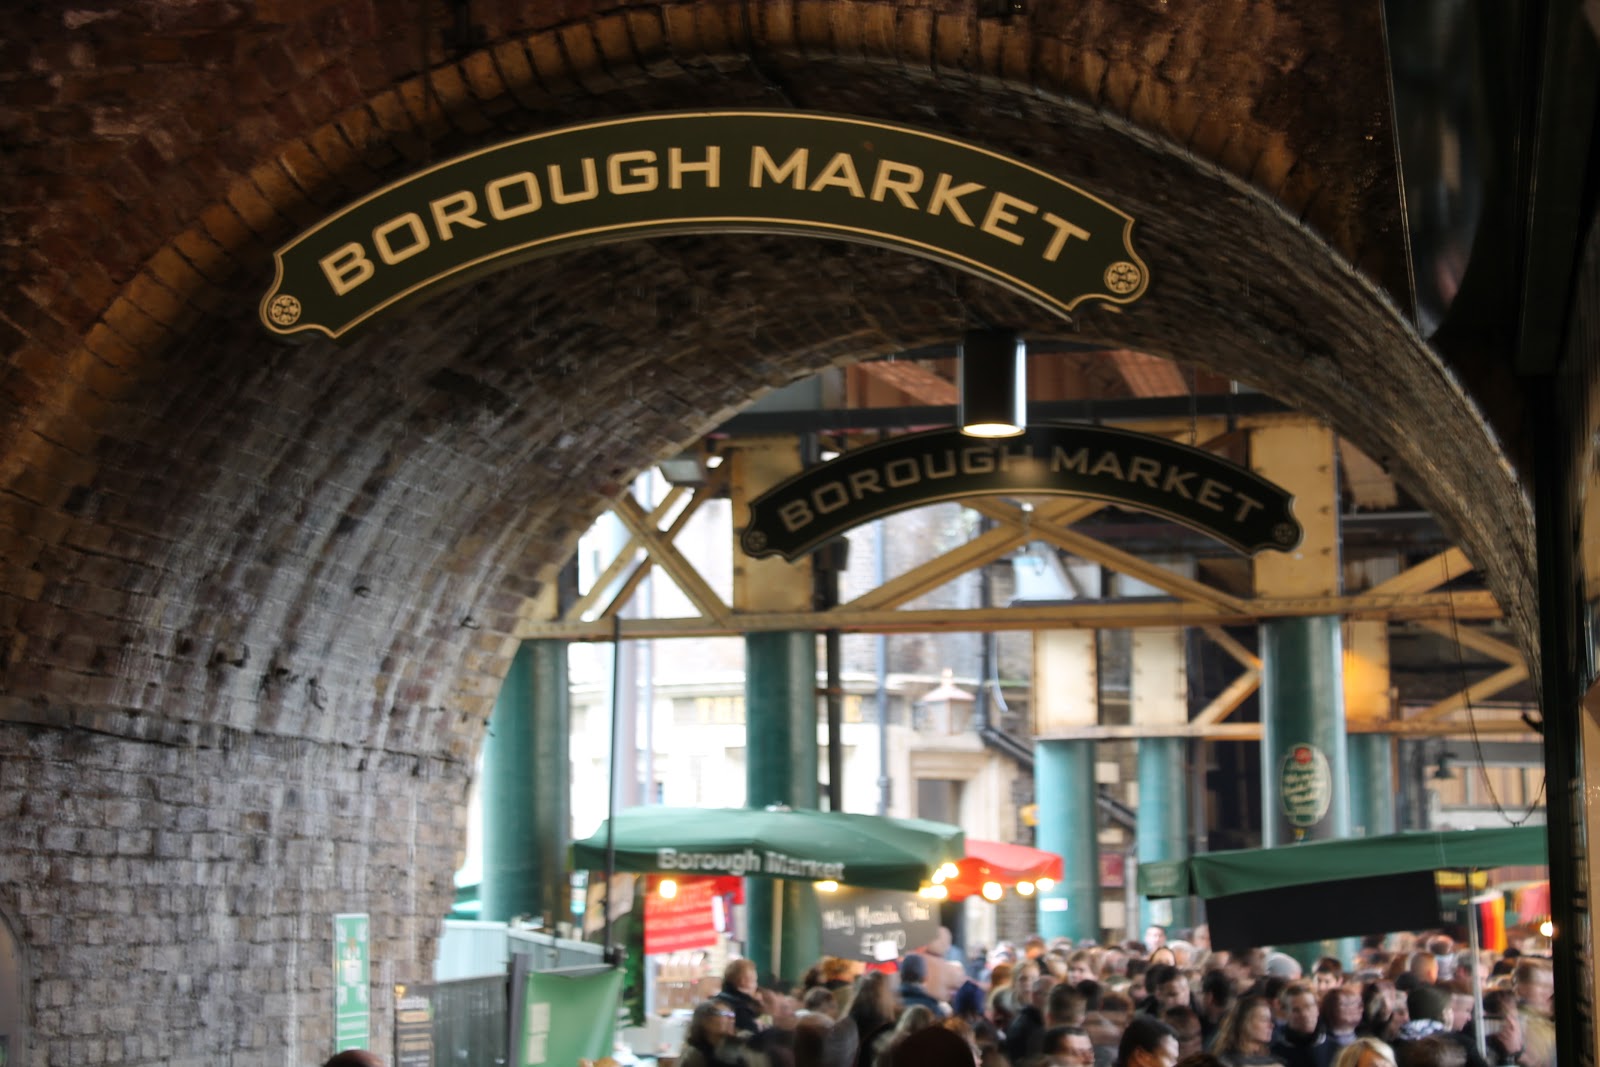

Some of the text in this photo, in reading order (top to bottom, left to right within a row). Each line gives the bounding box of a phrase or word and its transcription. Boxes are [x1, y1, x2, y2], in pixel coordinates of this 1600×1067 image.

[318, 145, 1091, 296] BOROUGH MARKET
[777, 444, 1265, 533] BOROUGH MARKET
[657, 847, 845, 880] Borough Market
